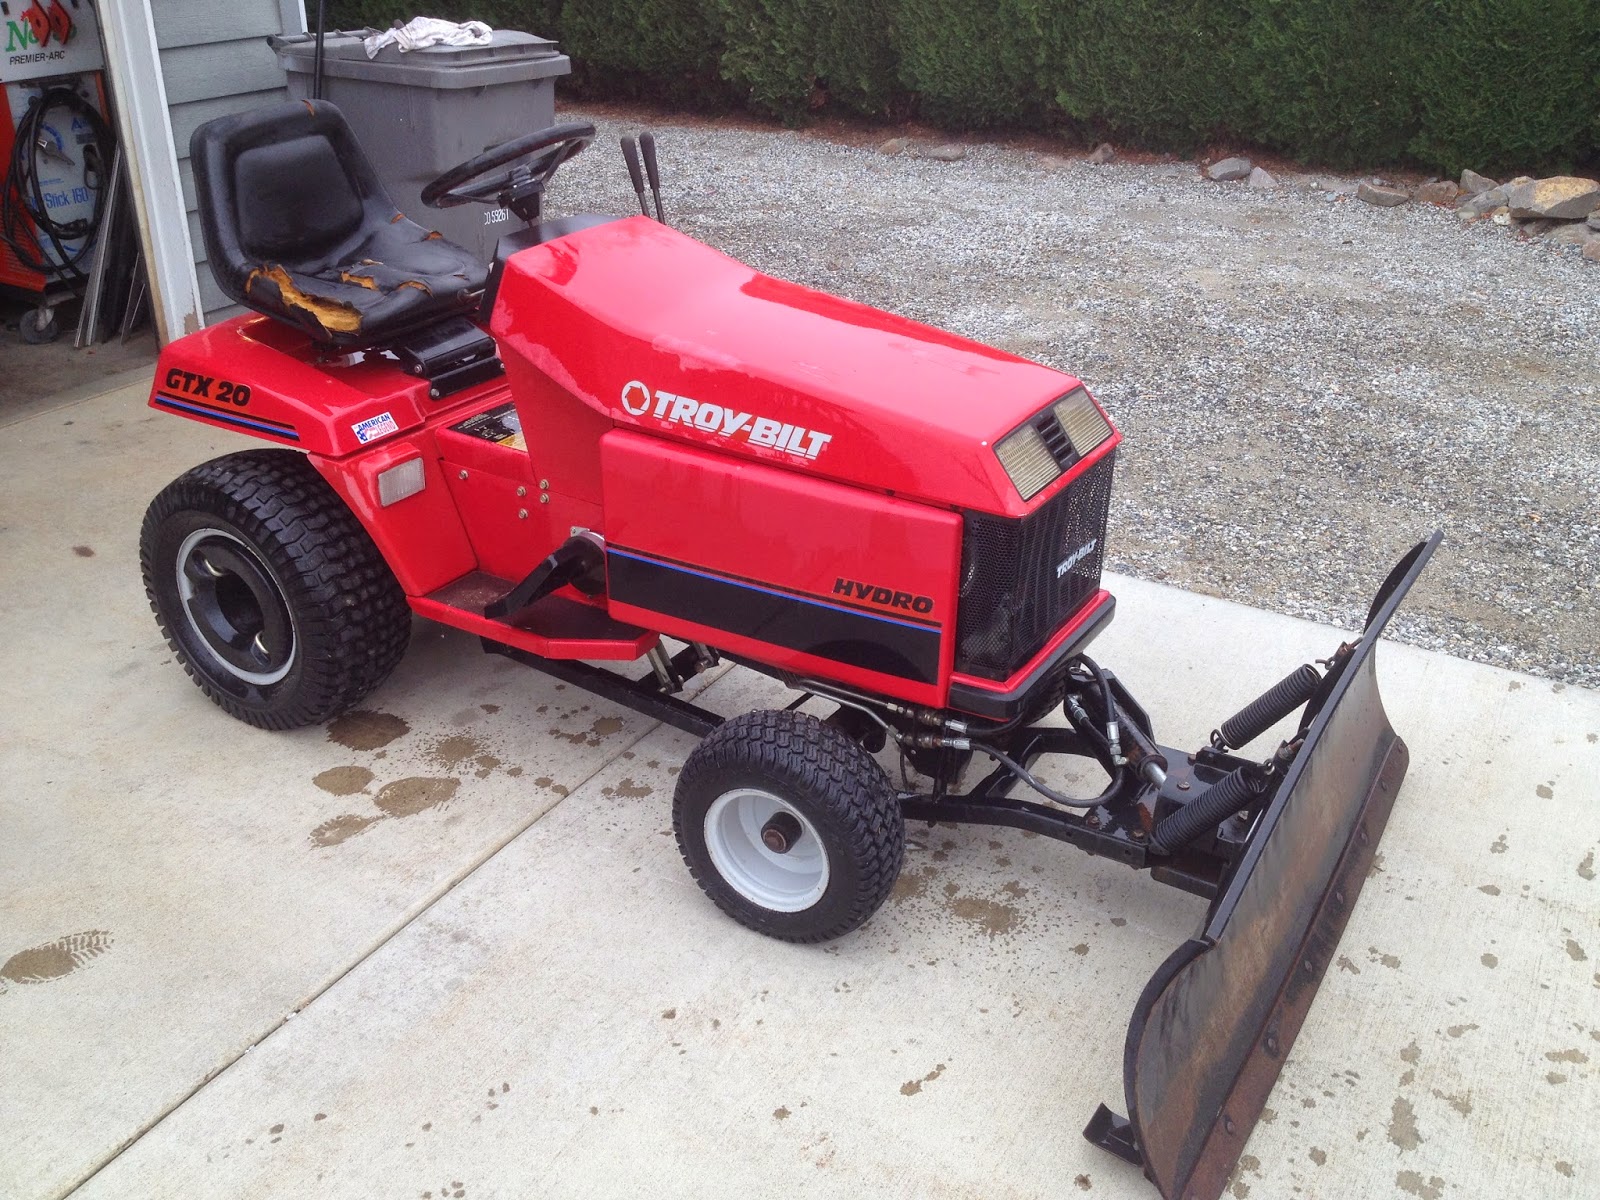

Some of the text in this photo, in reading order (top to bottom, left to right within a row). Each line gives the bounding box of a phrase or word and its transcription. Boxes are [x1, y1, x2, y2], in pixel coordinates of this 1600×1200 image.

[10, 50, 65, 65] PREMIER-ARC
[44, 191, 70, 208] Stick
[72, 187, 88, 203] 160
[491, 208, 509, 223] 59261
[166, 368, 251, 407] GTX 20
[358, 414, 390, 430] AMERICAN
[653, 390, 832, 460] TROY-BILT
[1057, 539, 1097, 578] TROY-BILT
[832, 577, 934, 614] HYDRO
